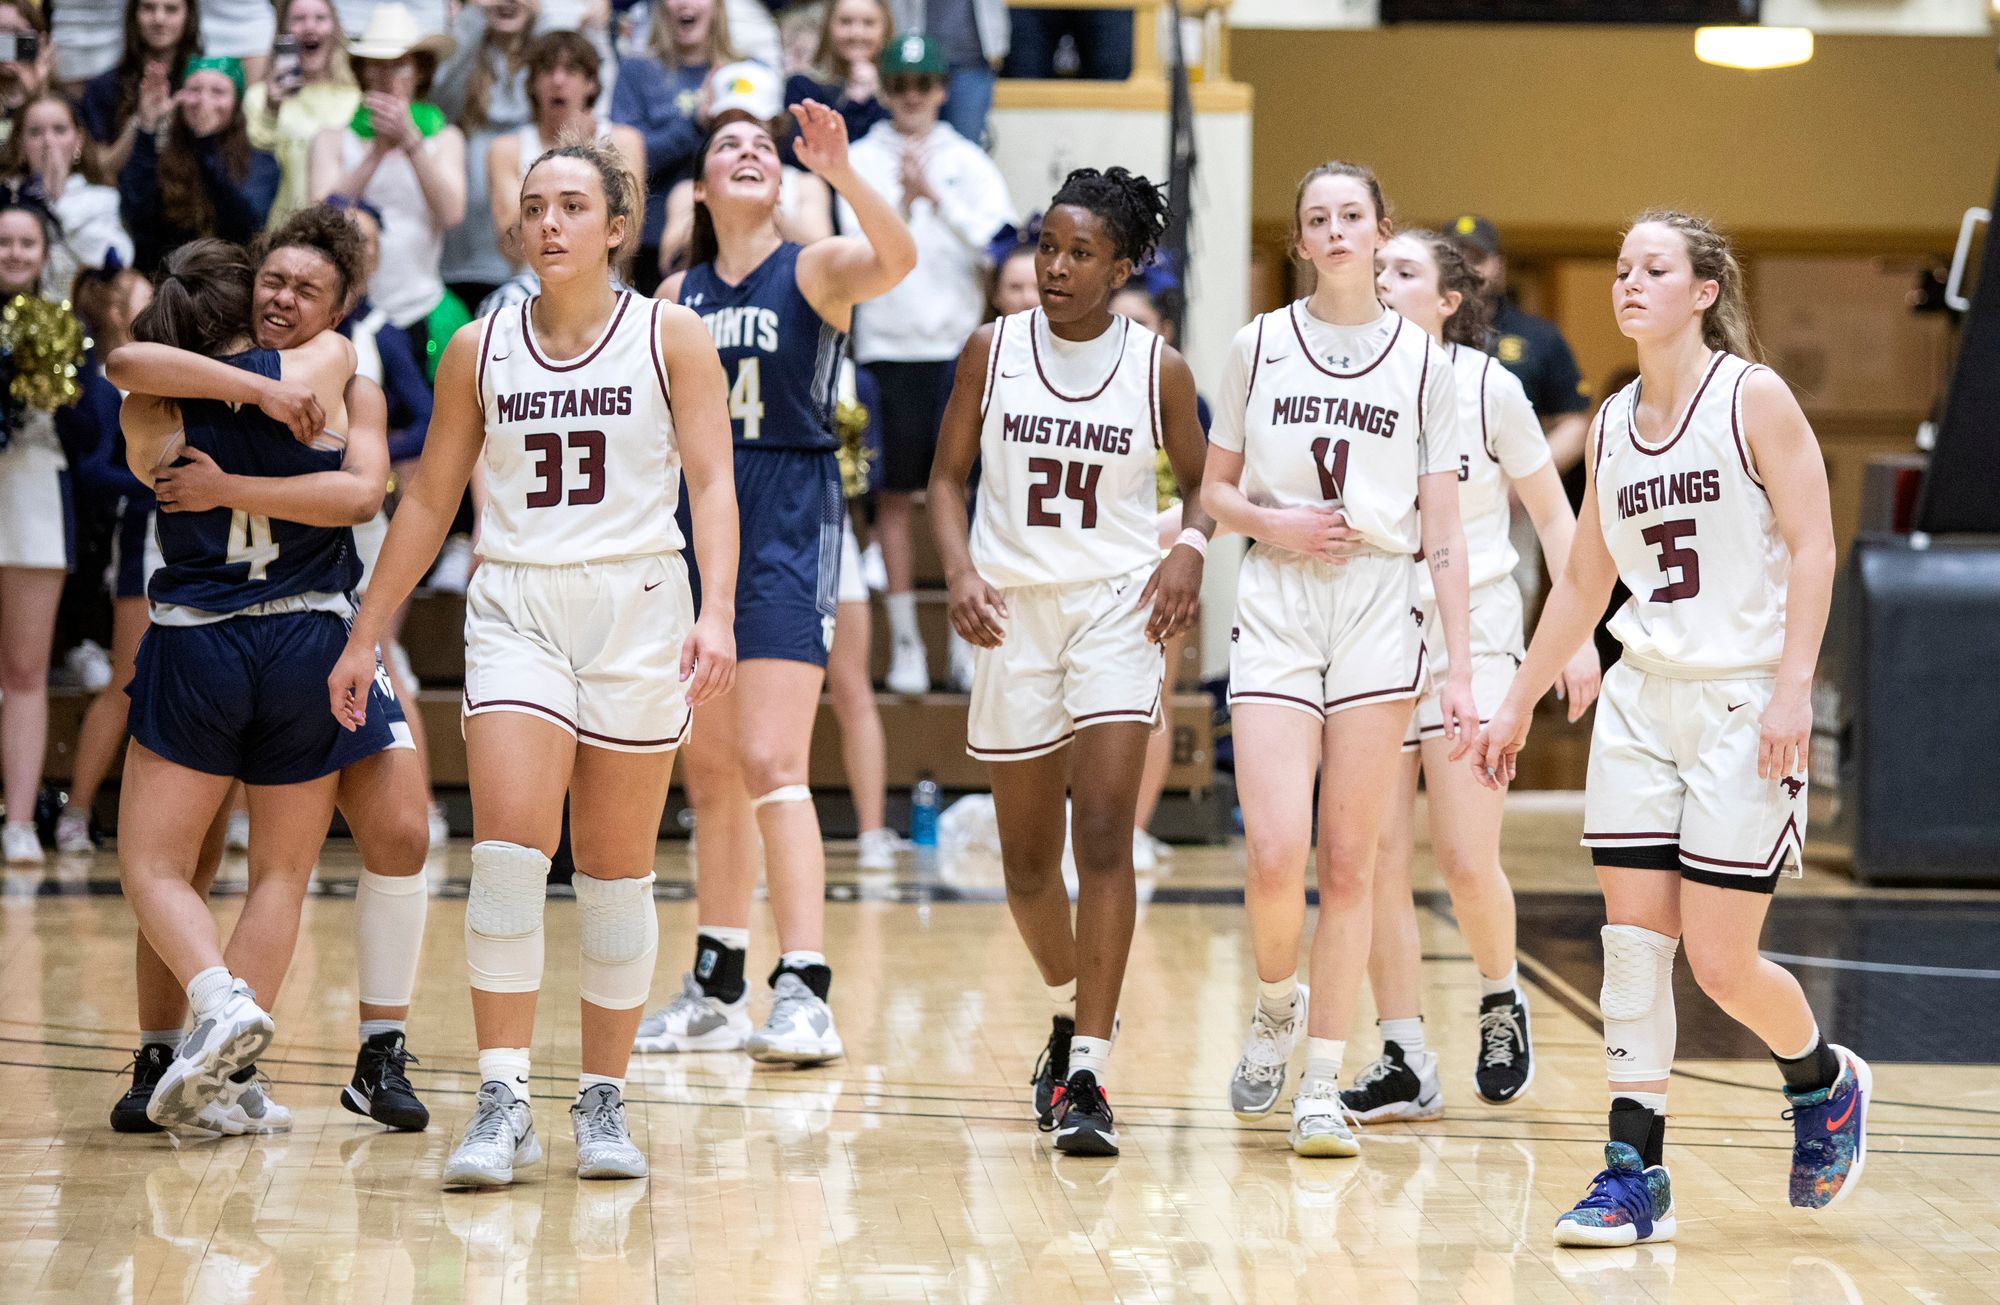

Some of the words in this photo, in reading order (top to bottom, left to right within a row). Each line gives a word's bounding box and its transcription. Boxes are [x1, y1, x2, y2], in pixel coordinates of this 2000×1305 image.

[701, 306, 779, 353] INTS
[497, 386, 632, 424] MUSTANGS
[723, 356, 765, 440] 4
[1271, 396, 1399, 439] MUSTANGS
[1003, 413, 1133, 455] MUSTANGS
[524, 430, 606, 509] 33
[1027, 457, 1104, 529] 24
[1310, 437, 1350, 501] 11
[225, 508, 280, 580] 4
